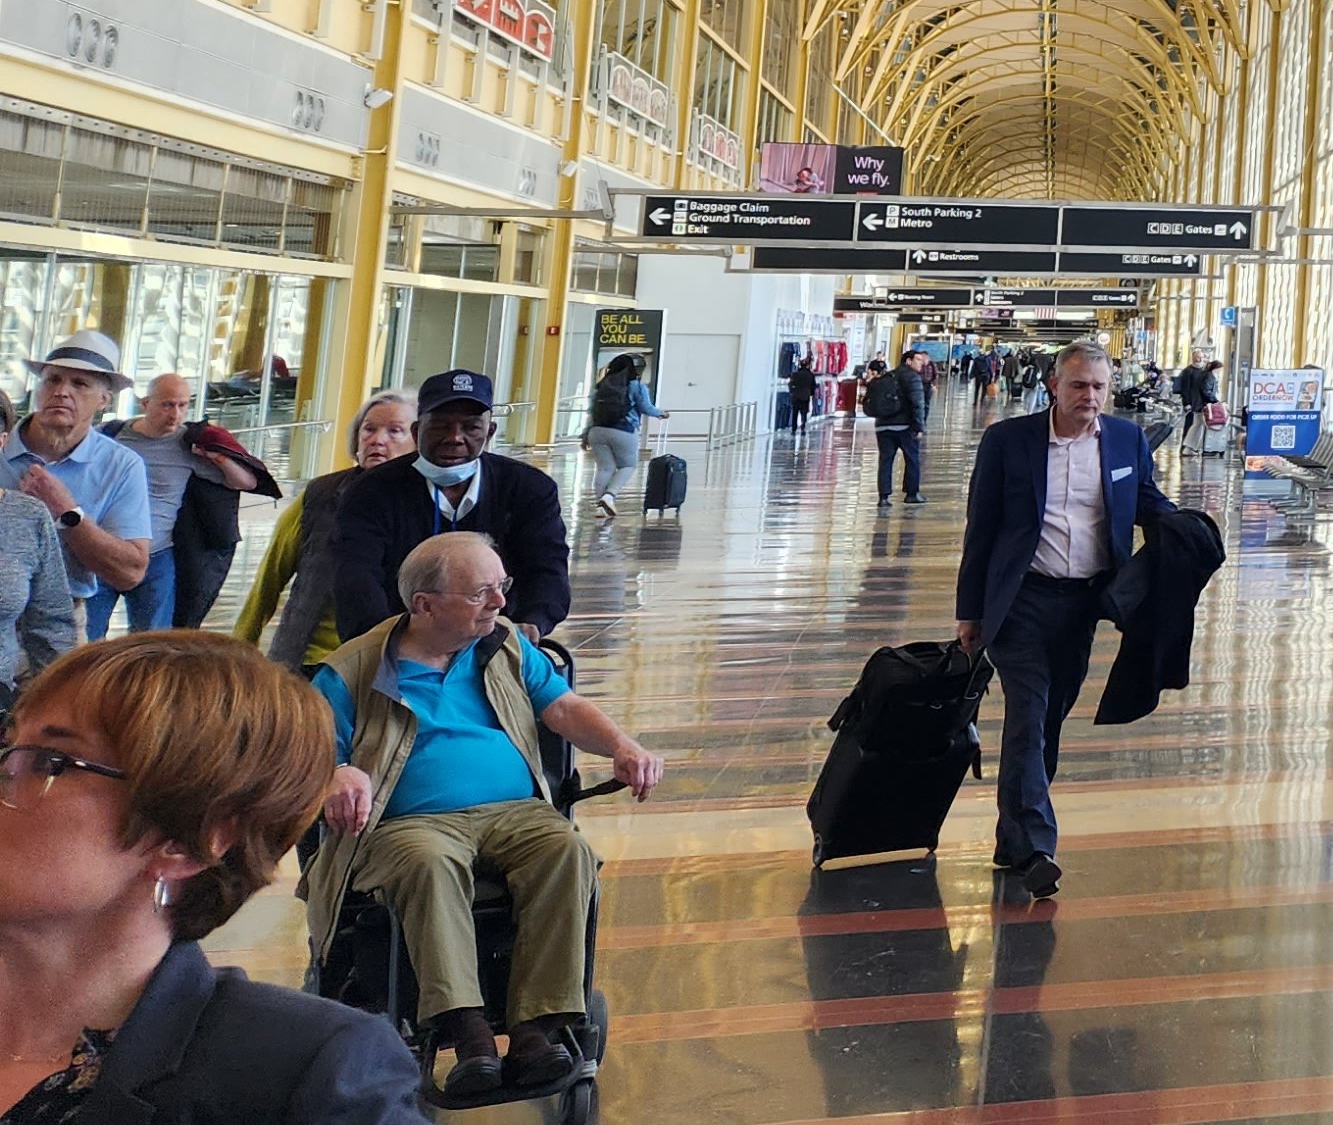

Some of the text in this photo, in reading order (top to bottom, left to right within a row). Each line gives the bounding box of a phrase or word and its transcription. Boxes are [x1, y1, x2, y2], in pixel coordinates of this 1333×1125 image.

[854, 156, 885, 172] Why
[848, 172, 890, 188] we fly.
[690, 201, 769, 214] Baggage Claim
[901, 207, 932, 217] South
[934, 208, 973, 220] Parking
[975, 209, 982, 218] 2
[689, 213, 811, 226] Ground Transportation
[900, 218, 933, 228] Metro
[688, 224, 709, 234] Exit
[1185, 225, 1212, 234] Gates
[940, 253, 979, 261] Restrooms
[1151, 256, 1171, 264] Gates
[601, 315, 643, 324] BE ALL
[601, 325, 627, 334] YOU
[600, 334, 627, 344] CAN
[1253, 382, 1286, 395] DCA
